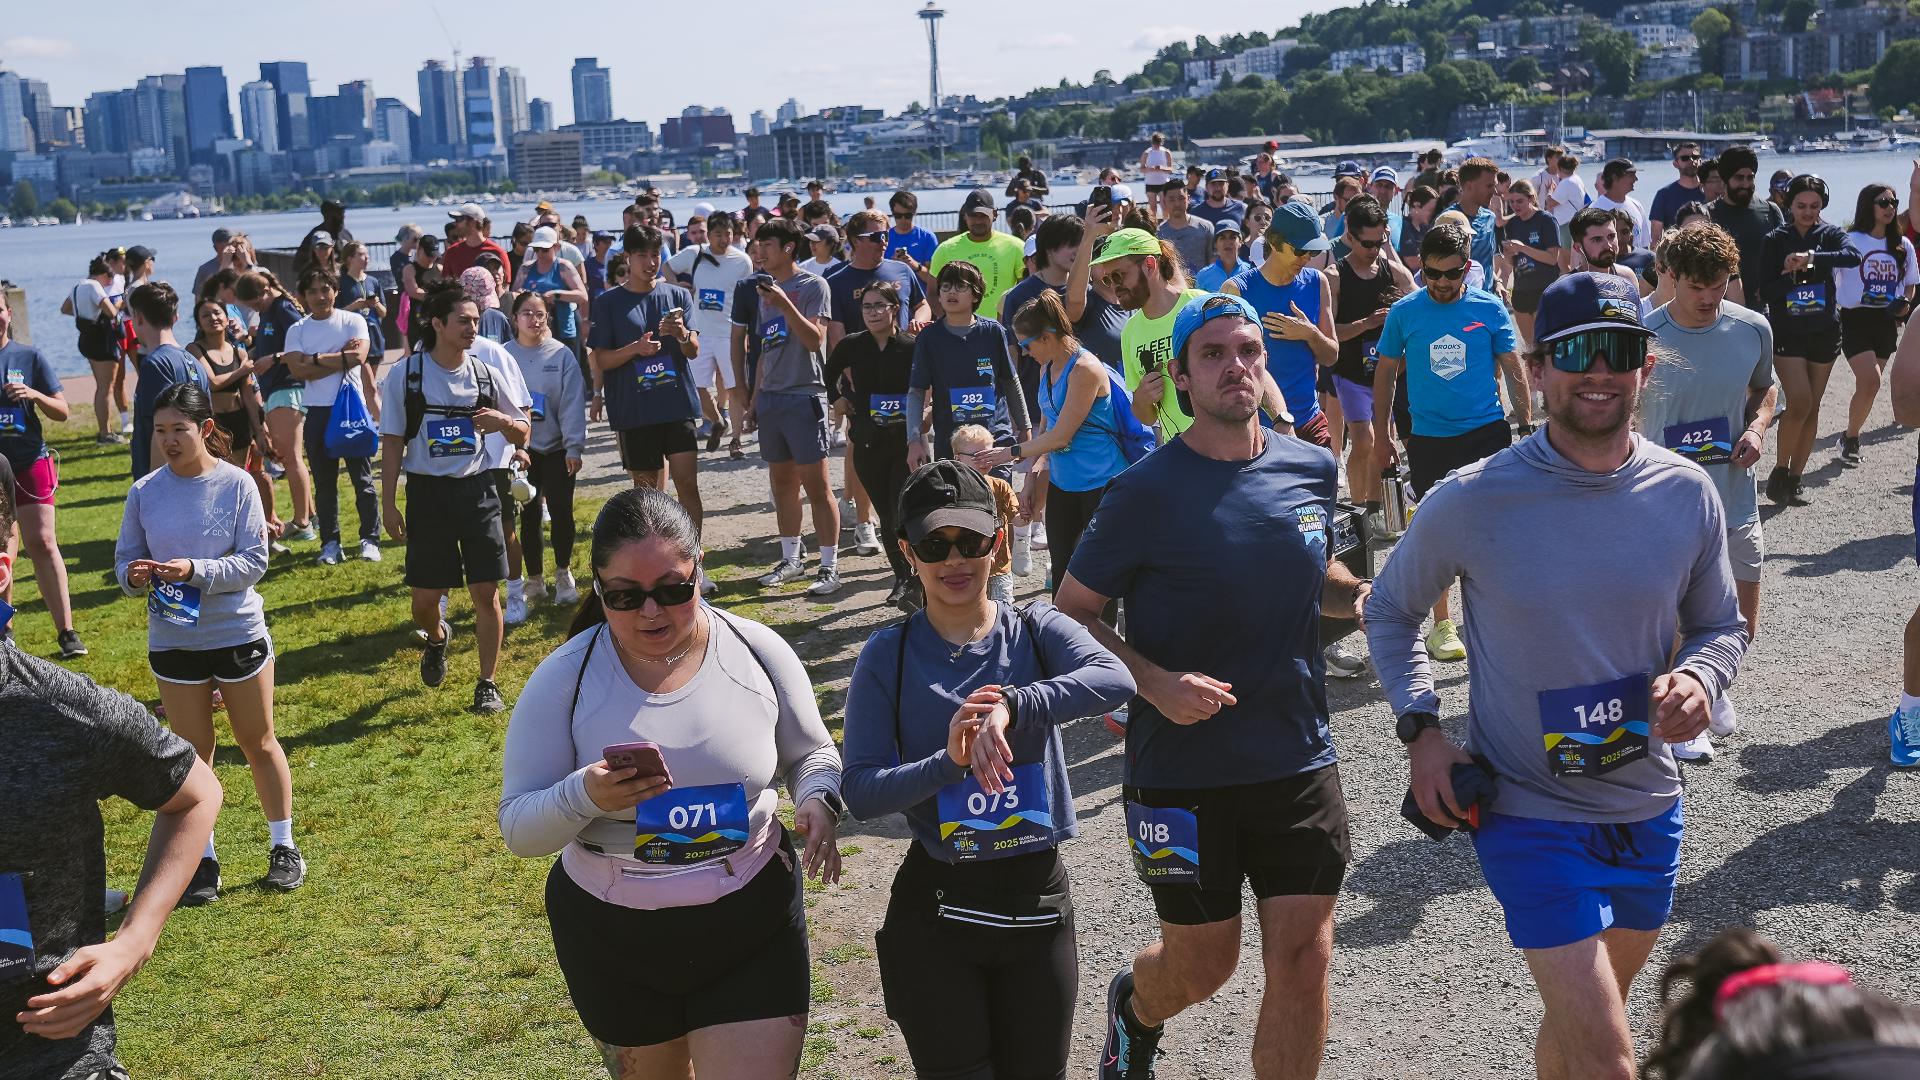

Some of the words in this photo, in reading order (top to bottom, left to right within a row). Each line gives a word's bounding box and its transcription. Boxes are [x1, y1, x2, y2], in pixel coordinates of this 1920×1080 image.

[1867, 259, 1896, 272] Run
[1870, 284, 1887, 292] 296
[1797, 290, 1815, 300] 124
[766, 323, 778, 336] 407
[1135, 335, 1172, 358] FLEET
[645, 363, 665, 374] 406
[880, 400, 900, 410] 273
[961, 394, 983, 404] 282
[440, 426, 460, 438] 138
[1681, 429, 1713, 445] 422
[1295, 506, 1317, 516] PARTY
[1299, 514, 1314, 524] LIKE
[1313, 513, 1319, 522] A
[1297, 521, 1324, 533] RUNNER
[158, 580, 184, 602] 299
[1574, 698, 1623, 729] 148
[1600, 750, 1621, 765] 2025
[967, 785, 1019, 816] 073
[668, 802, 718, 830] 071
[1138, 820, 1170, 843] 018
[959, 840, 975, 848] BIG
[993, 837, 1018, 851] 2025
[684, 850, 711, 859] 2025
